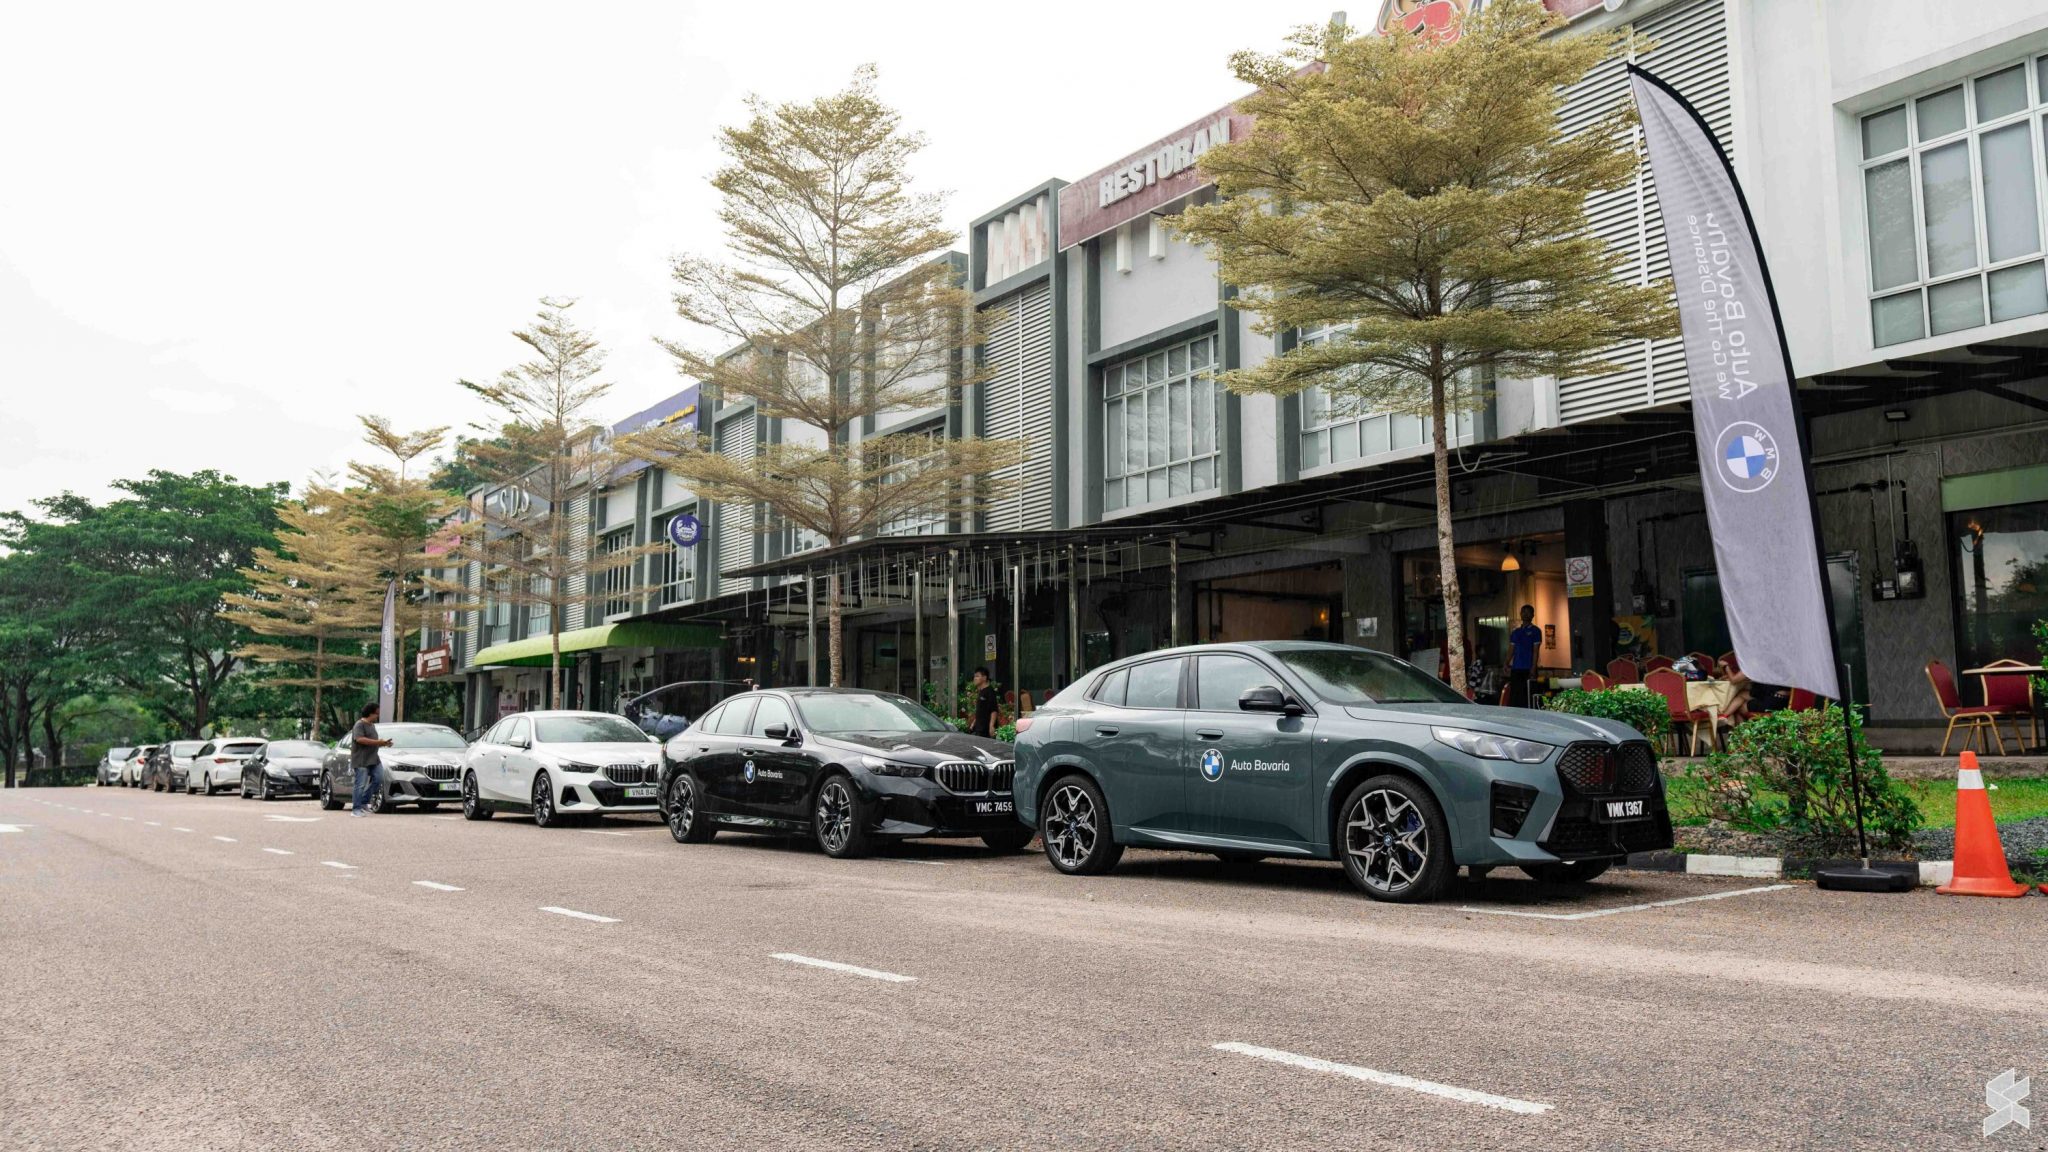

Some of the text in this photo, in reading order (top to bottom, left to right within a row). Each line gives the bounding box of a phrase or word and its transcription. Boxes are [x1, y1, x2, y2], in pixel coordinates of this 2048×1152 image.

[1099, 115, 1231, 208] RESTORAN
[1230, 759, 1290, 771] Auto Bavaria
[757, 768, 783, 779] Auto Bavaria
[975, 802, 993, 813] VMC
[1606, 800, 1643, 817] VMK 1367
